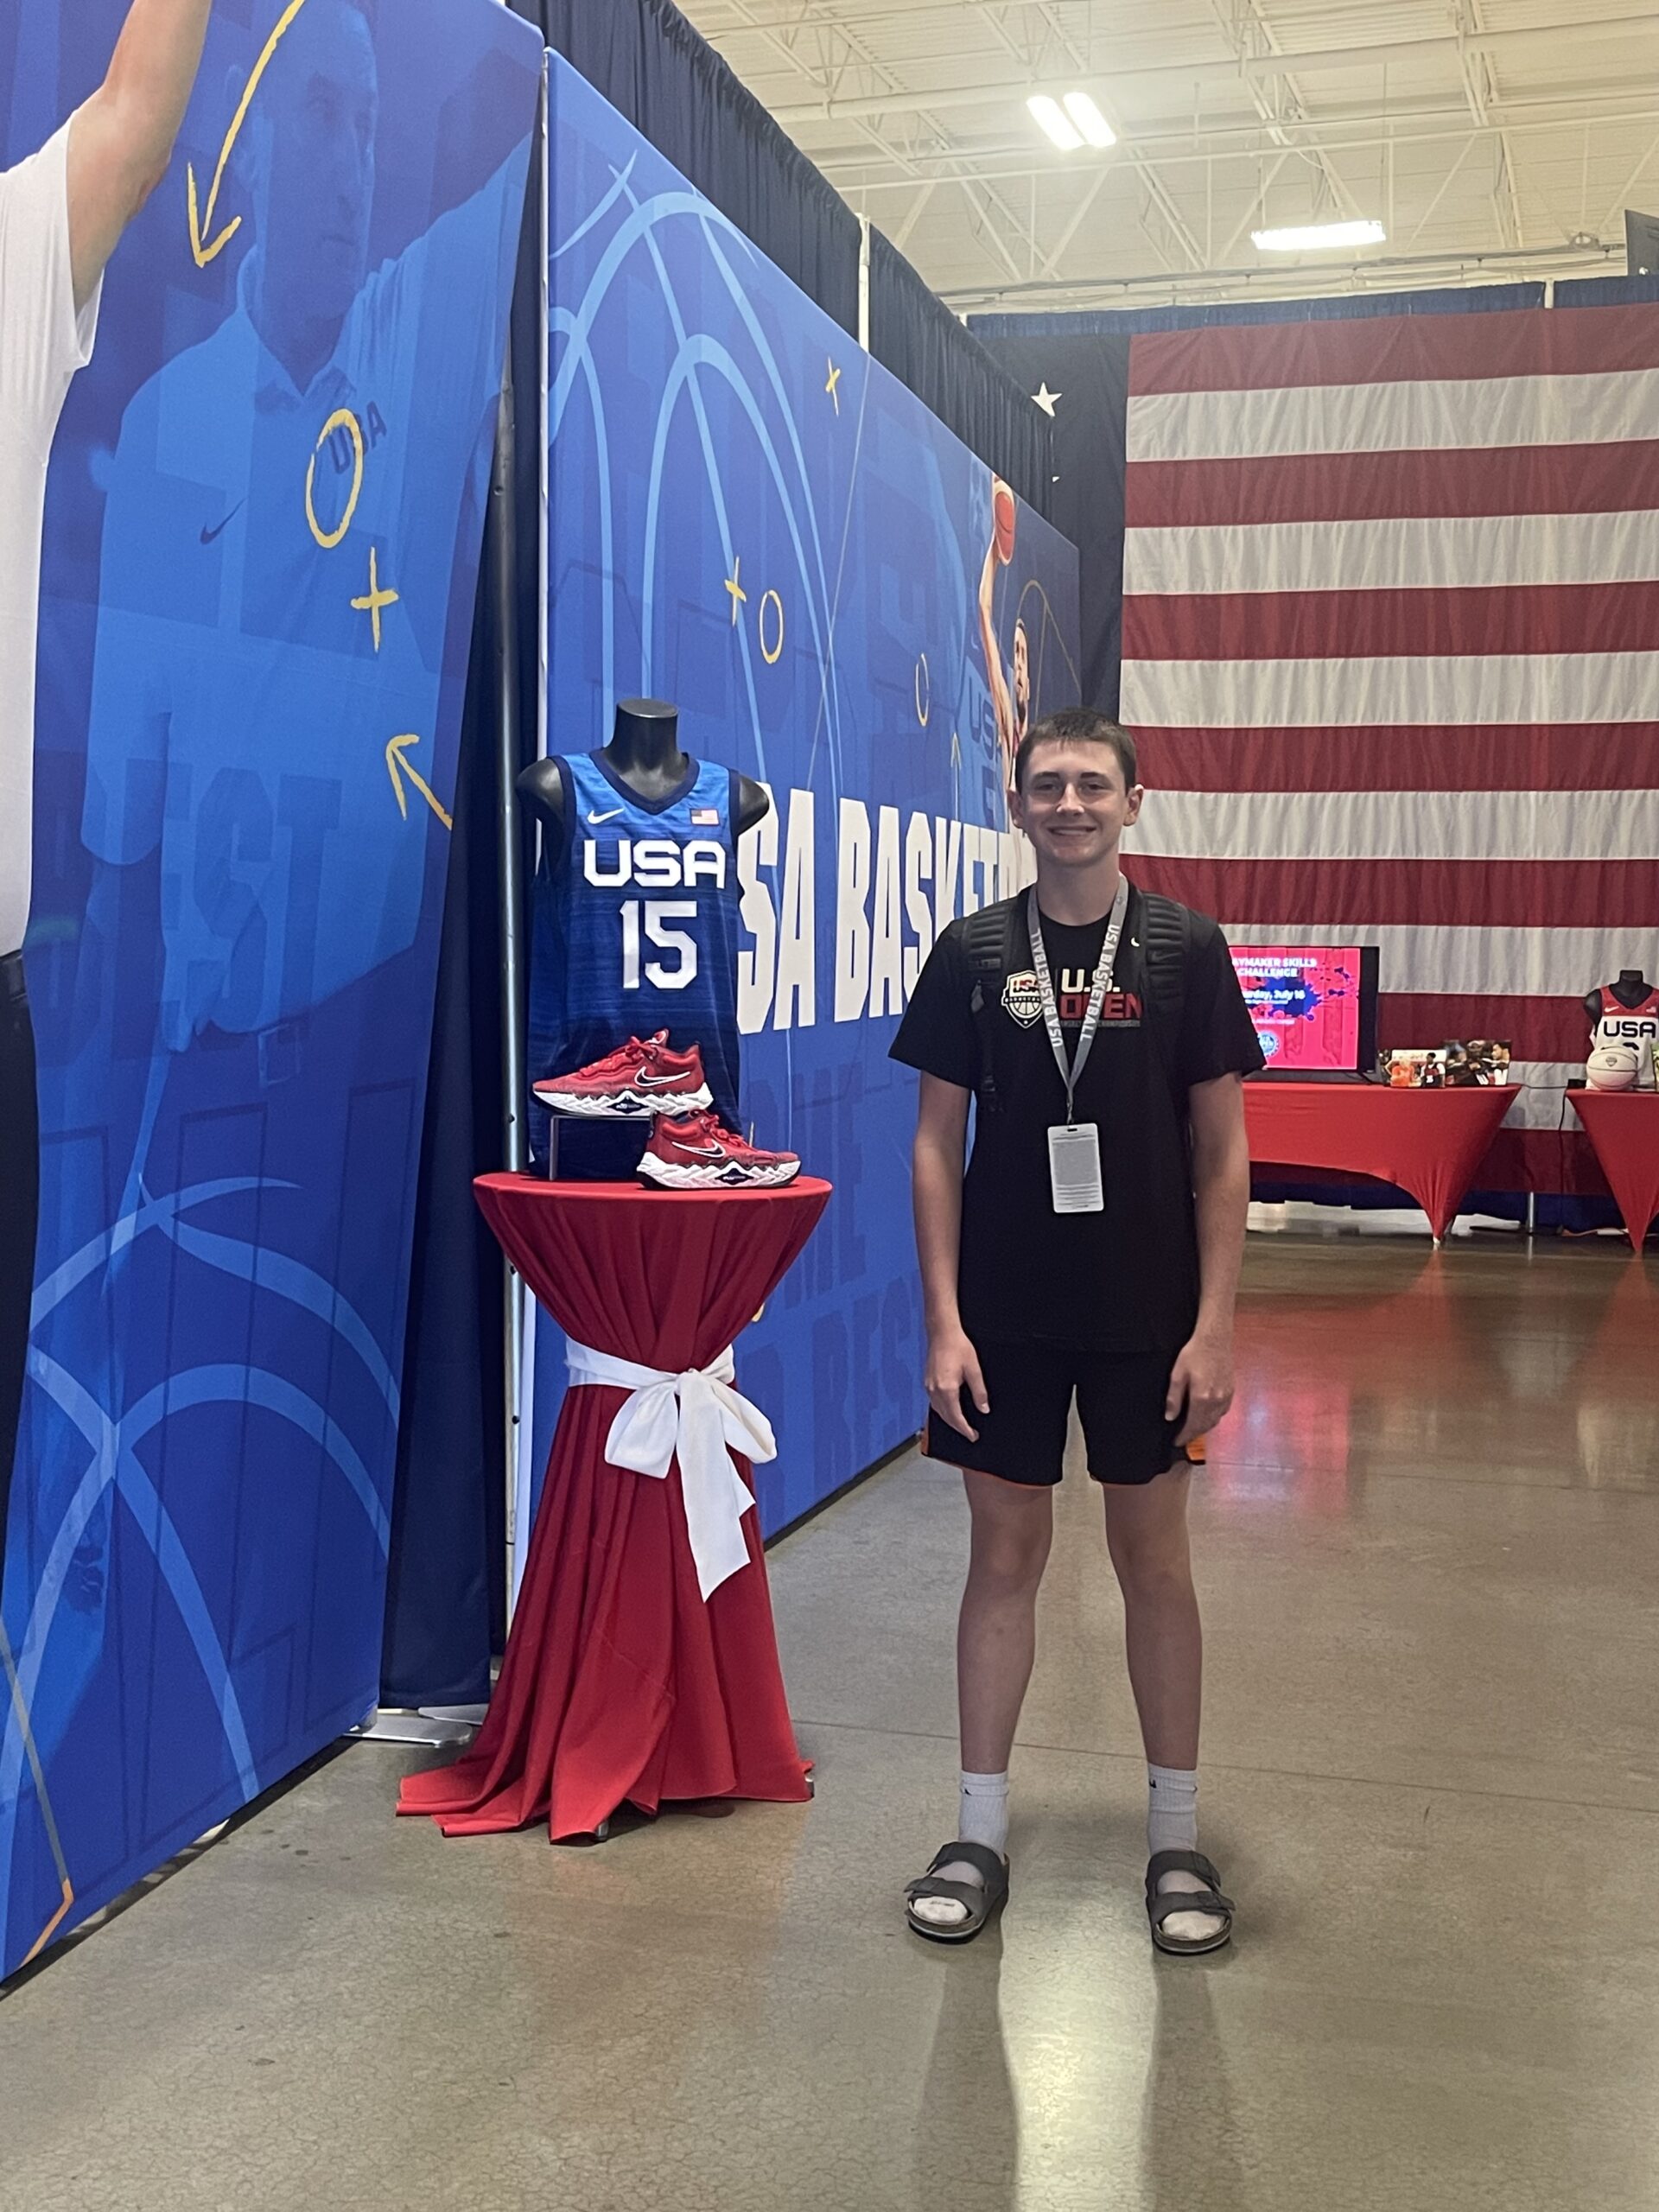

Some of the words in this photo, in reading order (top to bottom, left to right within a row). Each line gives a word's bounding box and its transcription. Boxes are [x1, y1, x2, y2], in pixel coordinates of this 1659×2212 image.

[583, 839, 726, 889] USA
[737, 782, 816, 1035] SA
[834, 798, 1038, 1023] BASKET
[620, 900, 697, 989] 15
[1103, 925, 1120, 953] USA
[1232, 957, 1281, 967] AYMAKER
[1031, 927, 1056, 1016] BASKETBALL
[1080, 954, 1114, 1041] BASKETBALL
[1047, 1019, 1063, 1047] USA
[1603, 1020, 1656, 1039] USA
